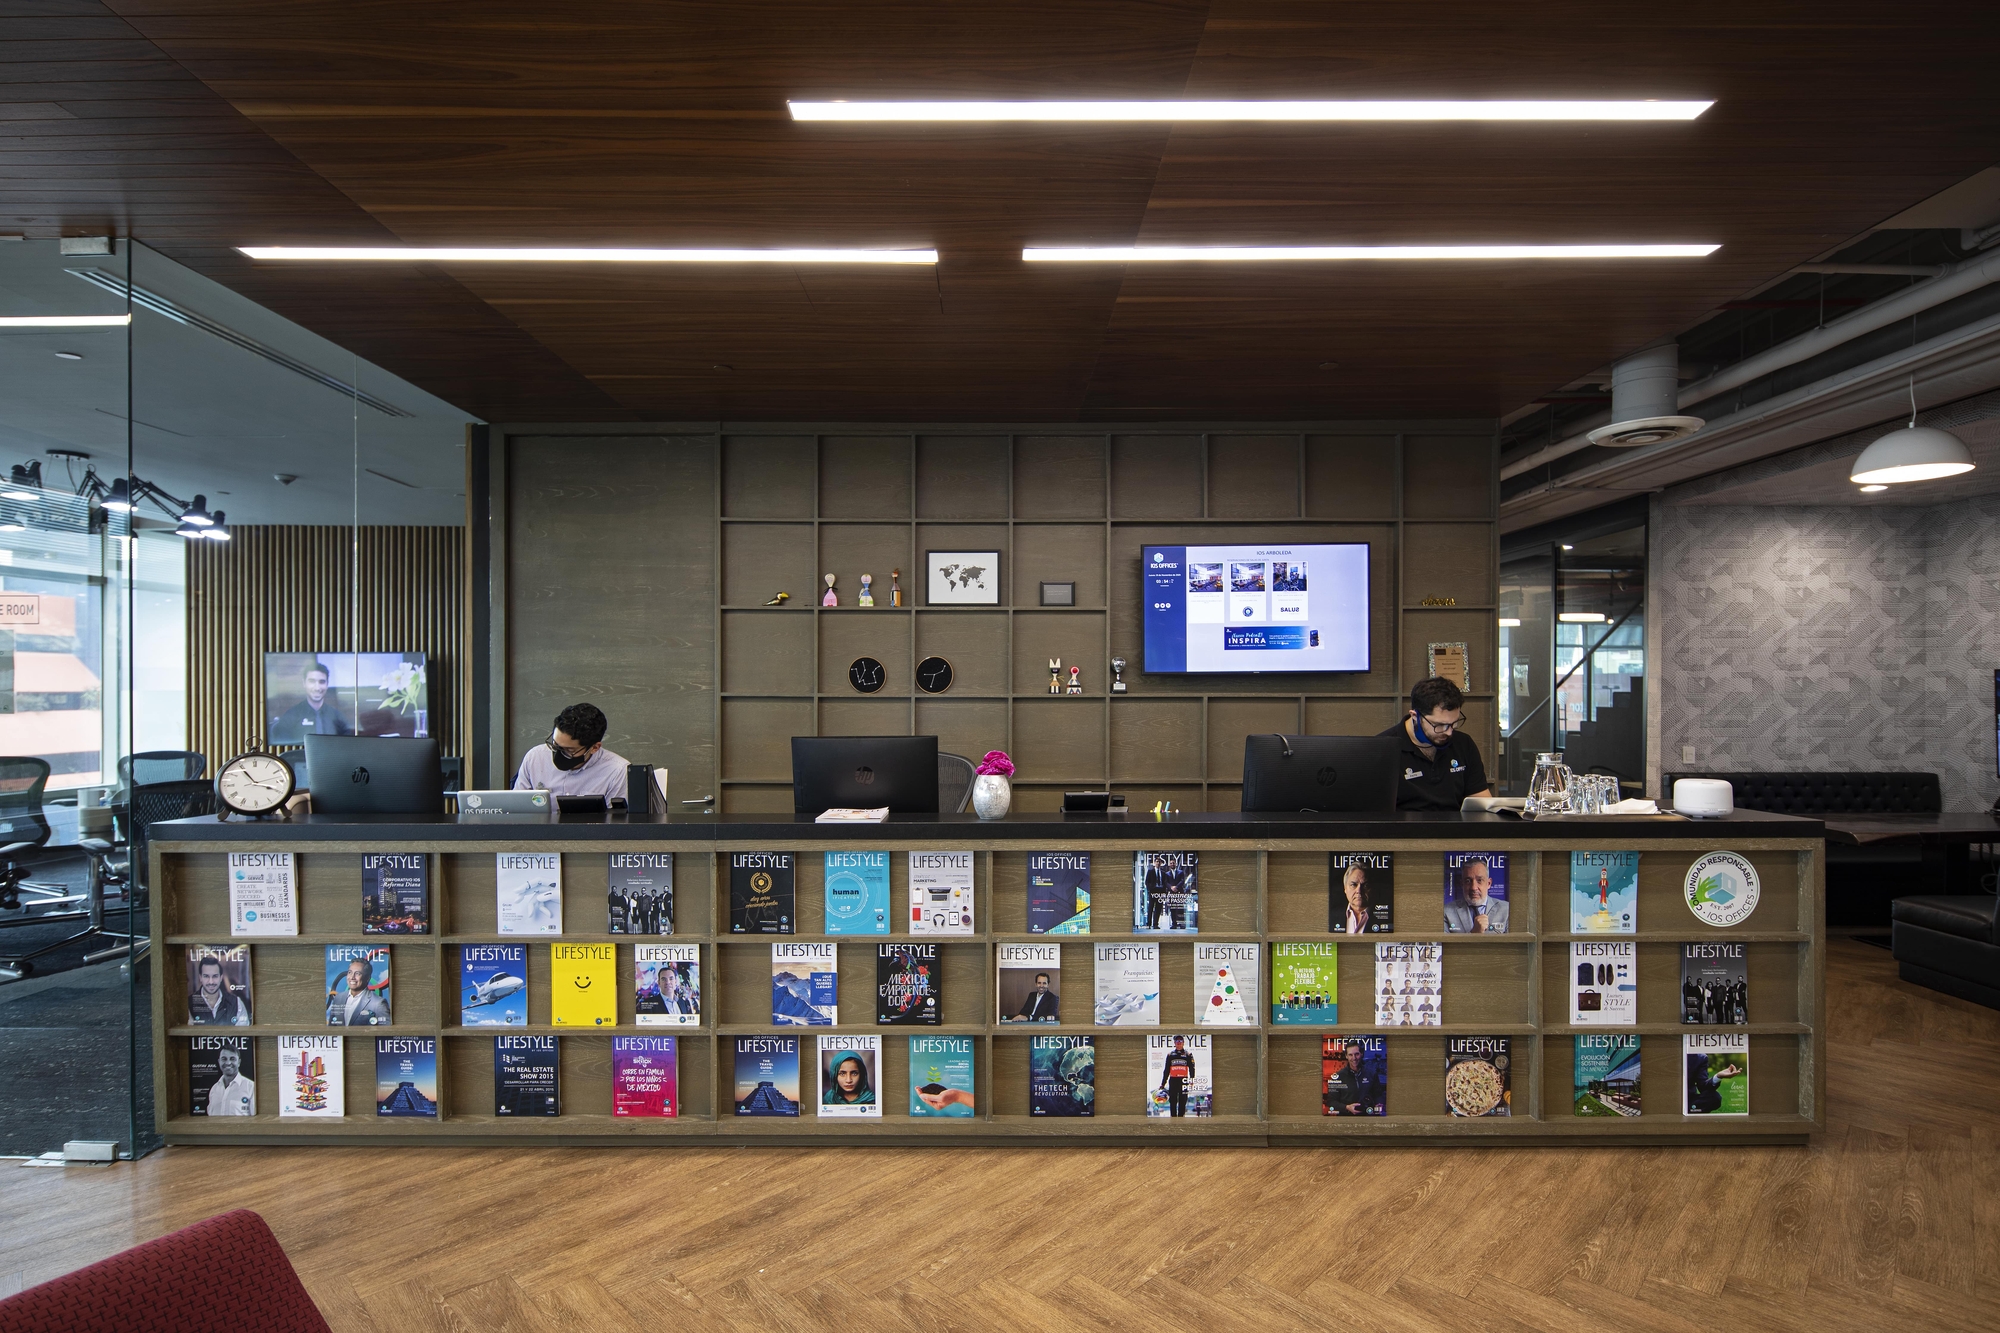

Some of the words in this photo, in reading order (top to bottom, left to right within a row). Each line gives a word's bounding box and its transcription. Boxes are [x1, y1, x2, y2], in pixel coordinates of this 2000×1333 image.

[7, 604, 34, 615] ROOM
[232, 854, 288, 867] LIFESTYLE
[502, 857, 555, 869] LIFESTYLE
[612, 855, 668, 868] LIFESTYLE
[734, 855, 789, 868] LIFESTYLE
[829, 854, 883, 866] LIFESTYLE
[913, 856, 968, 868] LIFESTYLE
[1032, 857, 1086, 869] LIFESTYLE
[1138, 854, 1193, 866] LIFESTYLE
[1450, 856, 1504, 868] LIFETYLE
[1576, 854, 1631, 866] LIFESTYLE
[1707, 856, 1754, 887] RESPONSABLE
[1690, 862, 1706, 911] COMUNIDAD
[1726, 894, 1754, 922] OFFICES
[1707, 912, 1722, 922] IOS
[466, 948, 521, 960] LIFESTYLE
[556, 947, 611, 959] LIFESTYLE
[640, 949, 694, 960] LIFESTYLE
[777, 944, 832, 956] LIFESTYLE
[880, 944, 935, 957] LIFESTYLE
[1001, 948, 1054, 960] LIFESTYLE
[1099, 948, 1154, 960] LIFESTYLE
[1199, 948, 1254, 960] LIFESTYLE
[1277, 943, 1332, 956] LIFESTYLE
[1380, 946, 1436, 959] LIFESTYLE
[1576, 943, 1631, 955] LIFESTYLE
[1687, 945, 1742, 958] LIFESTYLE
[190, 949, 244, 962] LIFESTYLE
[331, 949, 384, 962] LIFESTYLE
[192, 1037, 247, 1050] LIFESTYLE
[282, 1036, 338, 1048] LIFESTYLE
[379, 1040, 434, 1053] LIFESTYLE
[498, 1036, 554, 1049] LIFESTYLE
[616, 1038, 670, 1051] LIFESTYLE
[738, 1040, 794, 1053] LIFESTYLE
[821, 1037, 875, 1049] LIFESTYLE
[914, 1040, 970, 1052] LIFESTYLE
[1034, 1036, 1089, 1049] LIFESTYLE
[1152, 1035, 1207, 1048] LIFEYLE
[1451, 1040, 1506, 1052] LIFESTYLE
[1581, 1035, 1636, 1047] LIFESTYLE
[1690, 1034, 1744, 1047] LIFESTYLE
